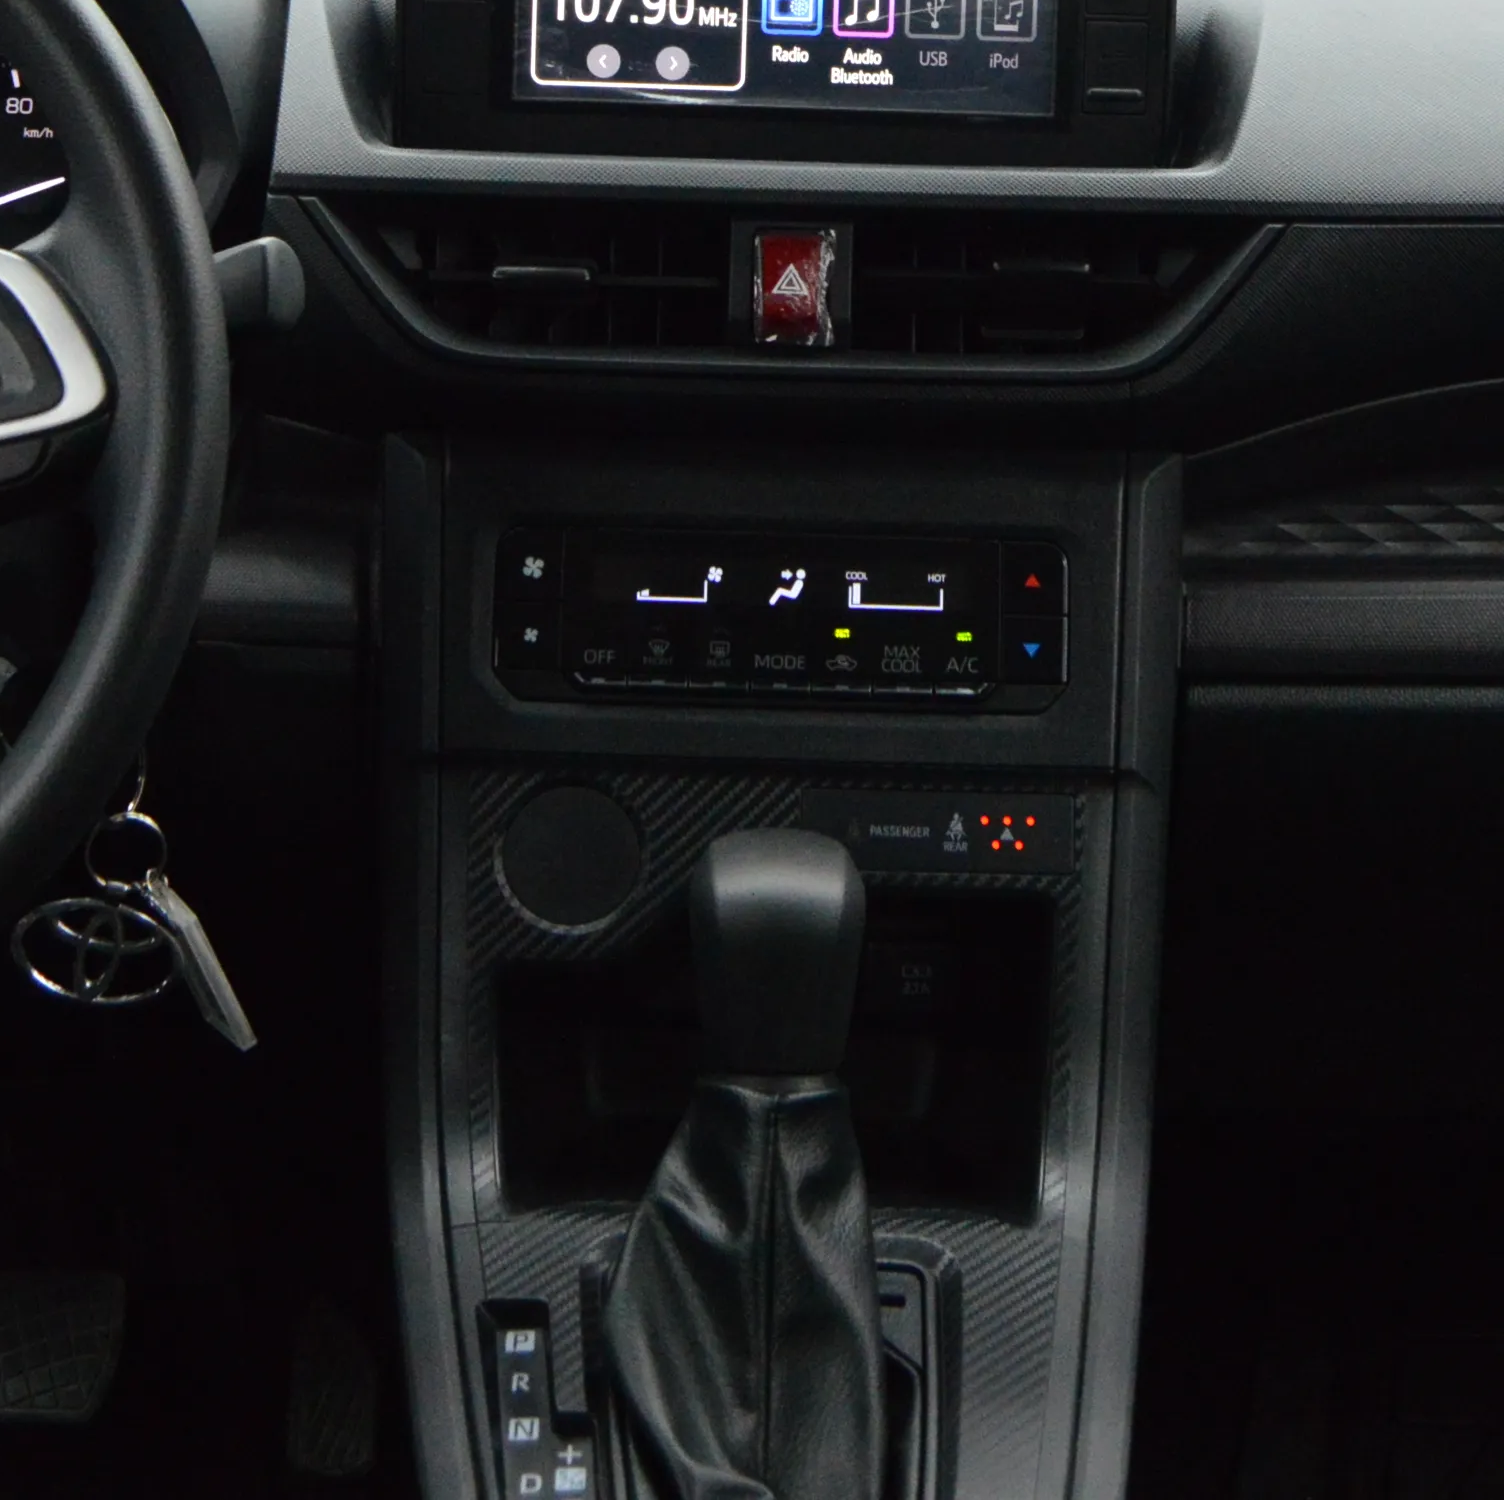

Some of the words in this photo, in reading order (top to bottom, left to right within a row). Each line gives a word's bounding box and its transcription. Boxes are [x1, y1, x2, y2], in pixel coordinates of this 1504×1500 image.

[699, 6, 738, 29] MHz
[772, 46, 809, 63] Radio
[843, 48, 882, 66] Audio
[919, 51, 948, 67] USB
[989, 53, 1019, 69] iPod
[831, 68, 893, 86] Bluetooth
[6, 97, 33, 114] 80
[23, 127, 54, 138] km/h
[845, 571, 868, 581] COOL
[927, 573, 946, 583] HOT
[584, 649, 616, 664] OFF
[884, 645, 921, 659] MAX
[754, 654, 806, 669] MODE
[881, 659, 922, 673] COOL
[946, 657, 979, 674] A/C
[869, 824, 931, 838] PASSENGER
[942, 841, 968, 853] REAR
[511, 1372, 530, 1392] R
[520, 1472, 543, 1495] D
